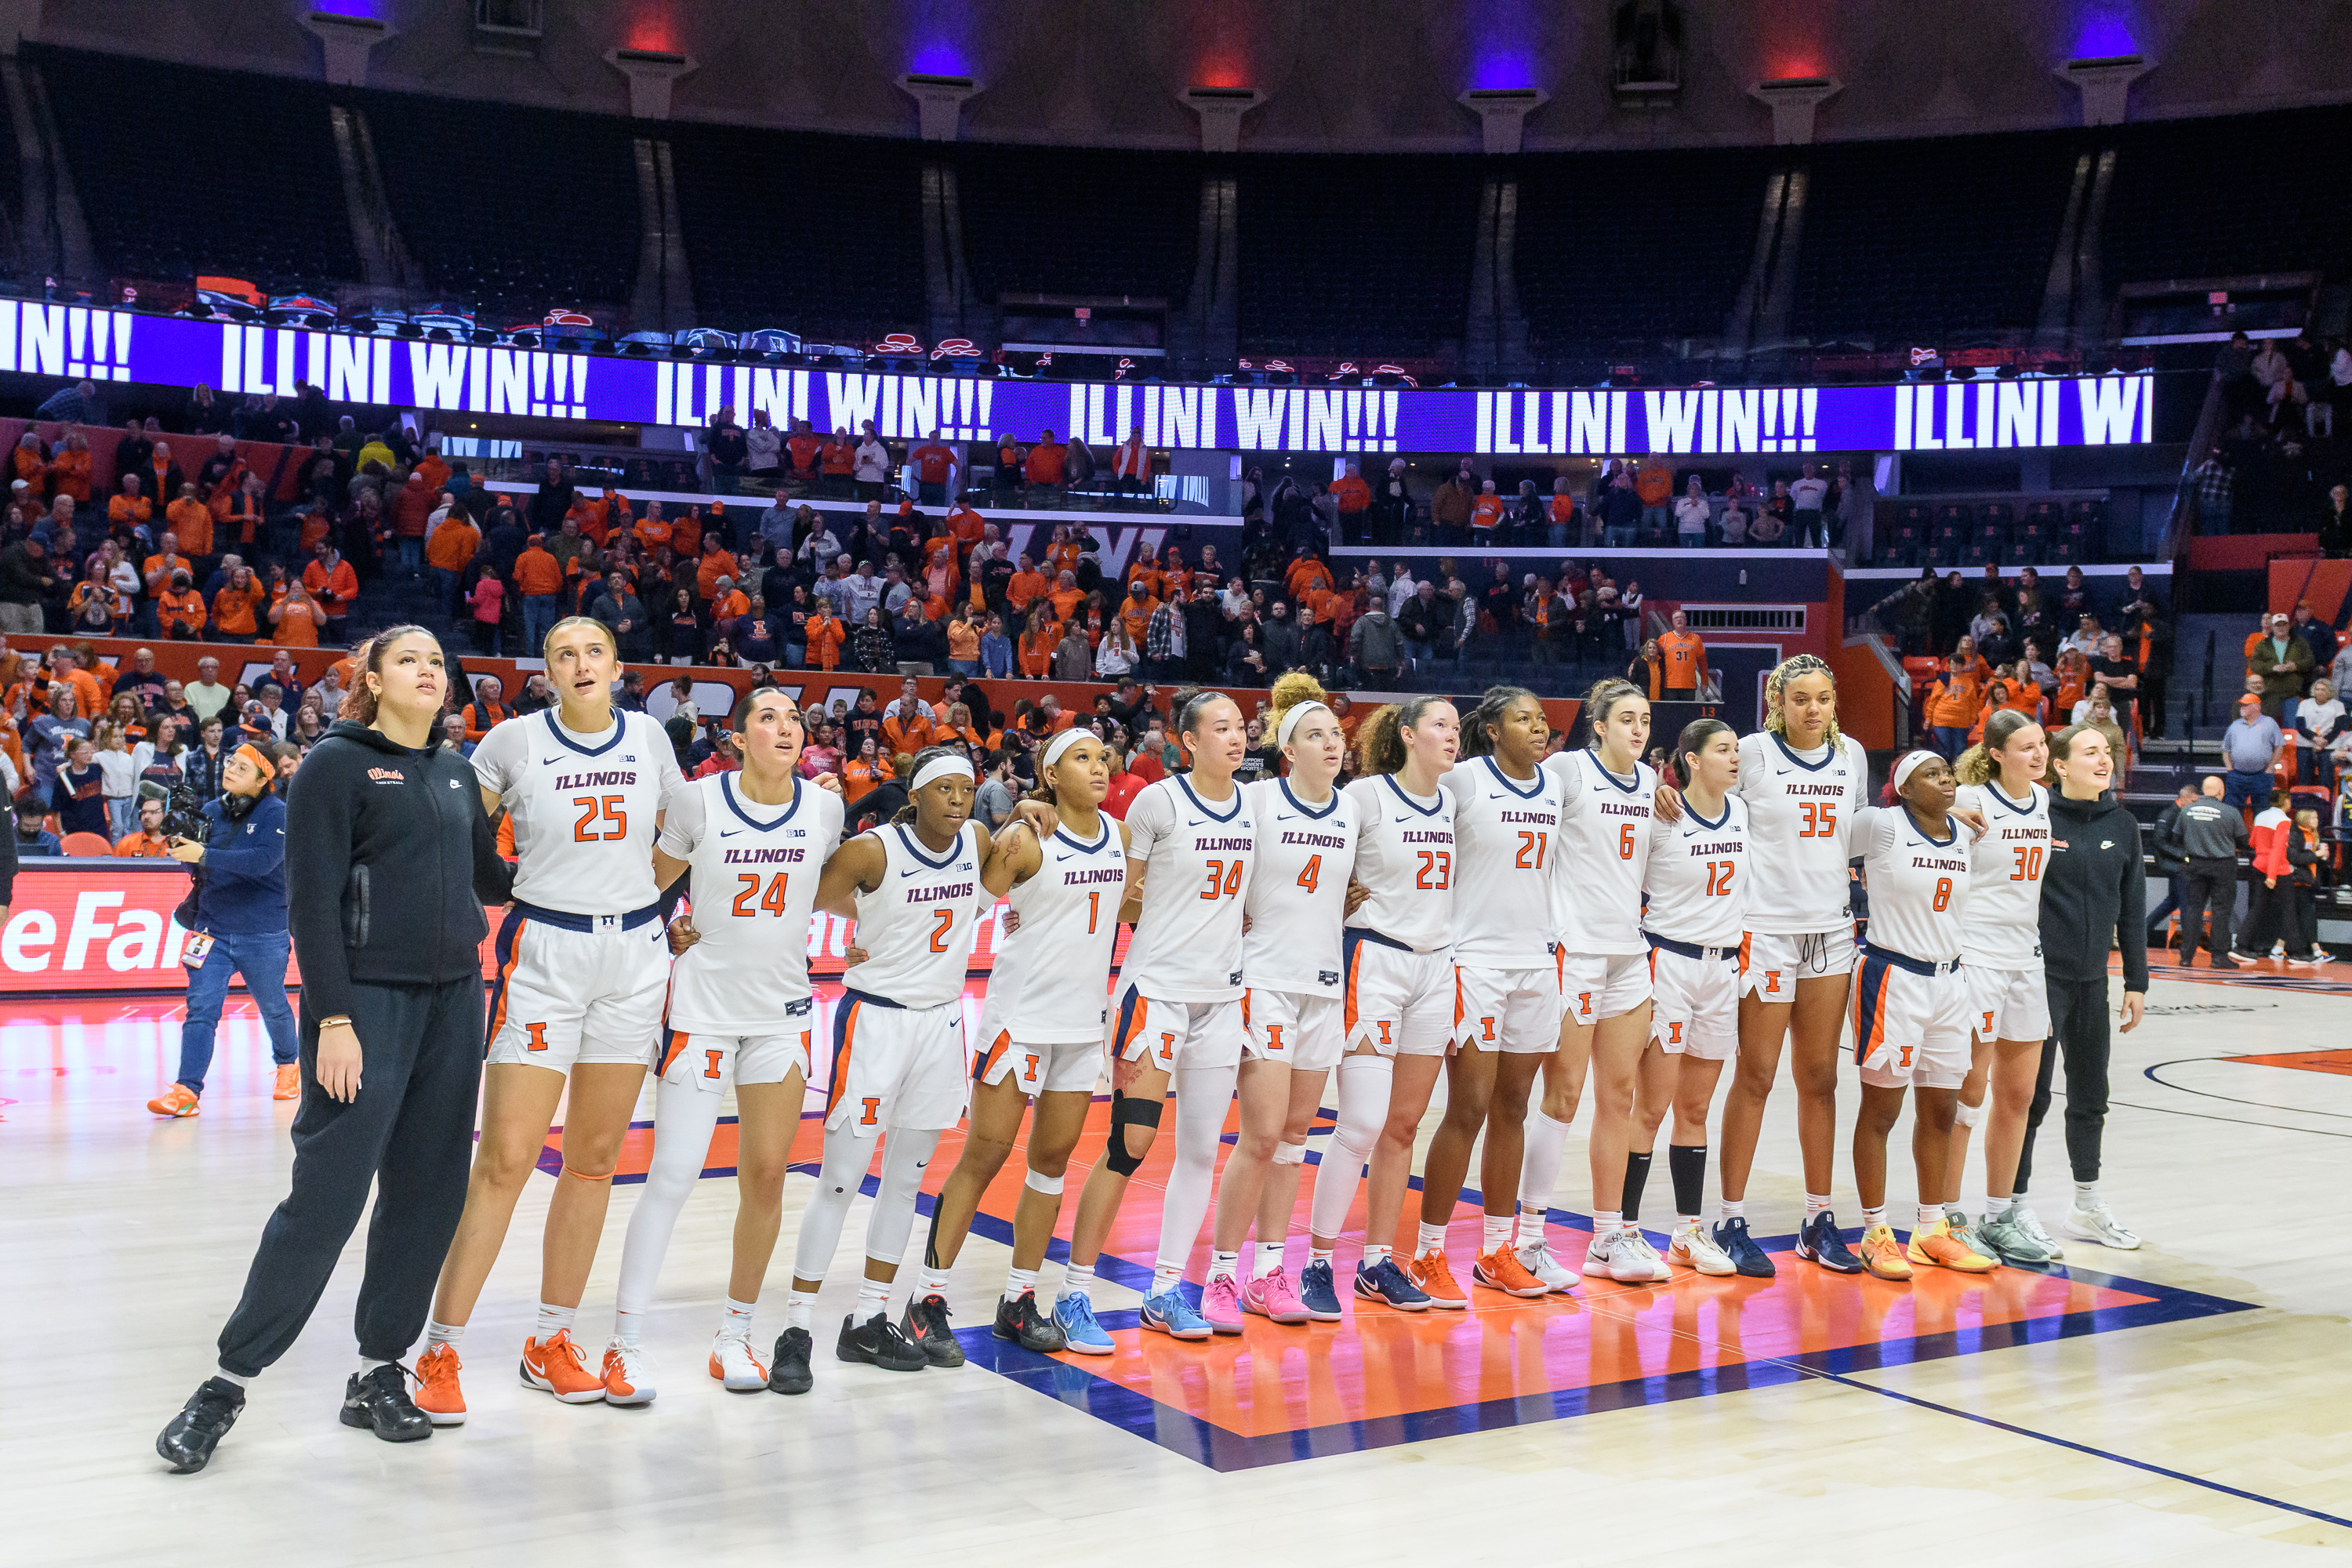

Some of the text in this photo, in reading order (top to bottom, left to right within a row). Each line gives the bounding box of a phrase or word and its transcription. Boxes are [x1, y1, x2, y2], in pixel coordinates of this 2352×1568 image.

[222, 323, 588, 419] ILLINI WIN!!!
[656, 361, 993, 441] ILLINI WIN!!!
[1069, 383, 1399, 452] ILLINI WIN!!!
[1893, 380, 2060, 451] ILLINI
[1475, 387, 1817, 454] ILLINI WIN!!!
[1675, 651, 1688, 662] 31
[1700, 706, 1715, 717] 13
[555, 771, 637, 790] ILLINOIS
[1786, 784, 1845, 796] ILLINOIS
[573, 795, 626, 842] 25
[1501, 811, 1556, 826] ILLINOIS
[1601, 803, 1650, 818] ILLINOIS
[1799, 802, 1836, 837] 35
[1195, 838, 1252, 851] ILLINOIS
[1281, 831, 1346, 849] ILLINOIS
[1403, 831, 1454, 844] ILLINOIS
[1515, 831, 1547, 869] 21
[1620, 823, 1635, 859] 6
[1690, 841, 1743, 856] ILLINOIS
[2002, 829, 2048, 840] ILLINOIS
[724, 848, 805, 864] ILLINOIS
[1417, 851, 1450, 890] 23
[1912, 857, 1966, 872] ILLINOIS
[2010, 847, 2042, 880] 30
[1064, 869, 1123, 885] ILLINOIS
[1200, 860, 1243, 900] 34
[1297, 855, 1322, 893] 4
[1707, 861, 1734, 896] 12
[731, 872, 789, 917] 24
[906, 882, 974, 903] ILLINOIS
[1933, 877, 1952, 912] 8
[1088, 891, 1100, 934] 1
[930, 909, 953, 953] 2
